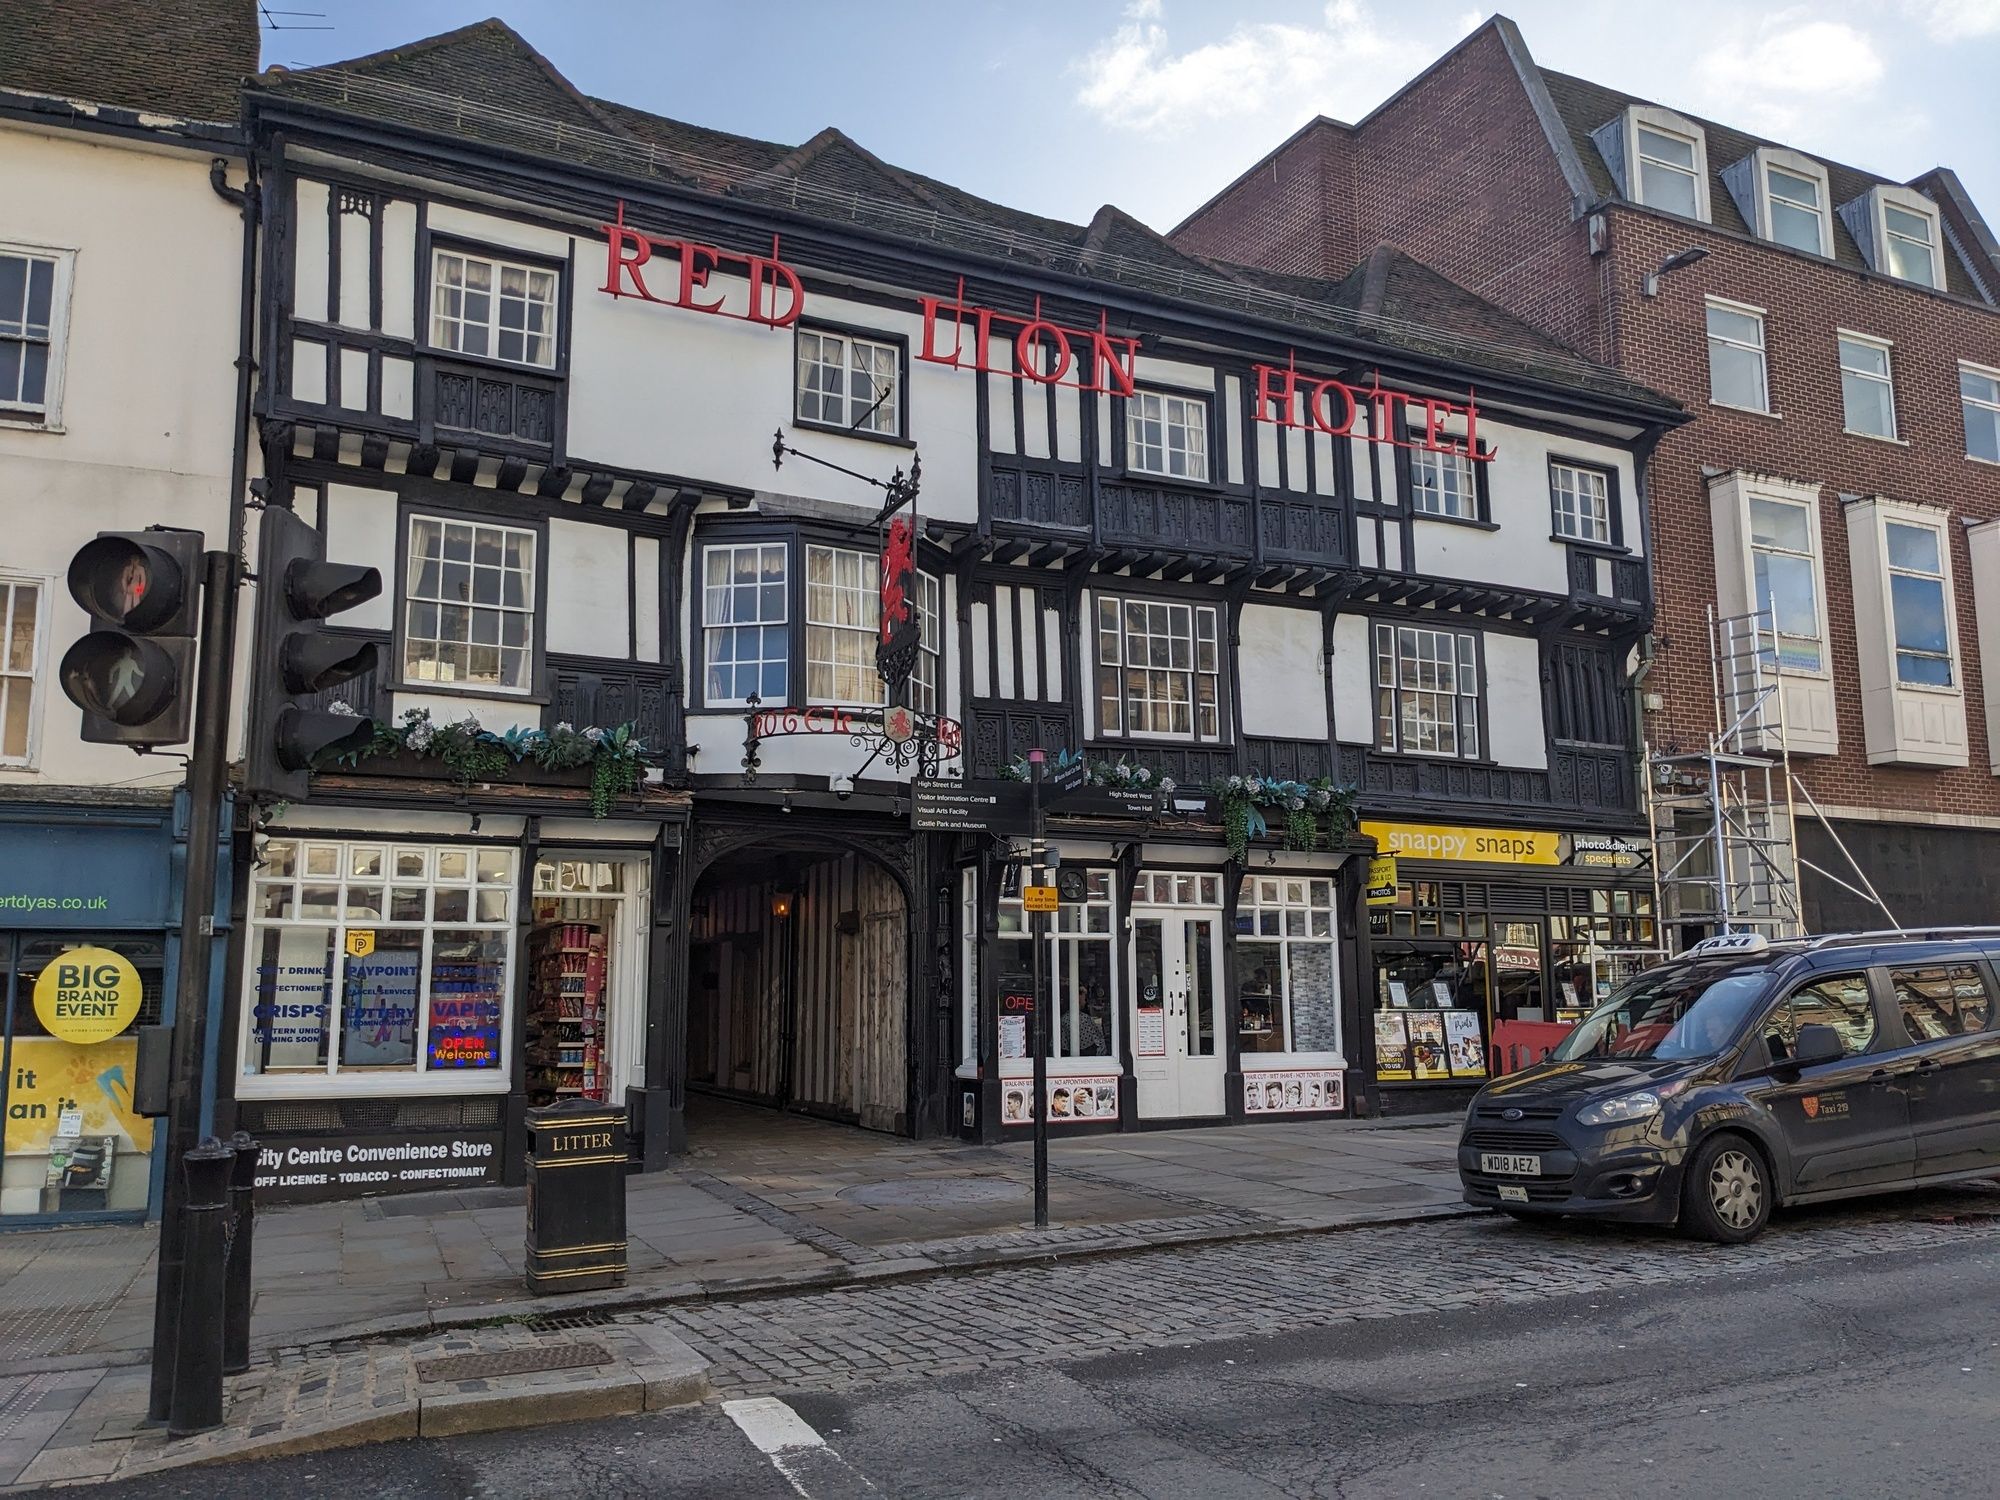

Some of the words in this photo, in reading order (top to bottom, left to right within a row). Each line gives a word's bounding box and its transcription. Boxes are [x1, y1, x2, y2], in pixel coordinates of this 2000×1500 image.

[598, 224, 804, 330] RED
[914, 294, 1142, 398] LION
[1251, 363, 1498, 461] HOTEL
[917, 780, 931, 788] High
[917, 793, 936, 801] Visitor
[937, 794, 969, 802] Information
[1108, 791, 1122, 799] High
[1122, 791, 1138, 799] Street
[1138, 792, 1152, 800] West
[949, 808, 968, 816] Facility
[1388, 830, 1467, 858] snappy
[1475, 837, 1535, 861] snaps
[1575, 838, 1639, 854] photo&digital
[1584, 854, 1631, 865] specialists
[1370, 888, 1391, 896] PHOTOS
[1696, 938, 1751, 951] TAXI
[58, 965, 121, 989] BIG
[256, 967, 285, 975] ST
[350, 966, 417, 977] PAYPOINT
[255, 985, 327, 993] CFECTIONER
[57, 990, 120, 1002] BRAND
[56, 1003, 118, 1016] EVENT
[1005, 996, 1035, 1011] OPE
[253, 1004, 327, 1019] CRISPS
[252, 1027, 296, 1035] WTERN
[299, 1027, 323, 1035] UNIO
[254, 1036, 296, 1044] (CMING
[442, 1037, 485, 1049] OPEN
[435, 1050, 491, 1060] Welcome
[16, 1068, 37, 1089] it
[1820, 1104, 1836, 1114] Taxi
[553, 1133, 613, 1152] LITTER
[287, 1146, 343, 1165] Centre
[347, 1142, 448, 1162] Convenience
[451, 1140, 493, 1157] Store
[1487, 1155, 1510, 1171] WD18
[1512, 1157, 1534, 1173] AEZ
[254, 1176, 277, 1187] OFF
[279, 1173, 328, 1187] LICENCE
[339, 1171, 390, 1184] TOBACCO
[400, 1166, 487, 1180] CONFECTIONARY
